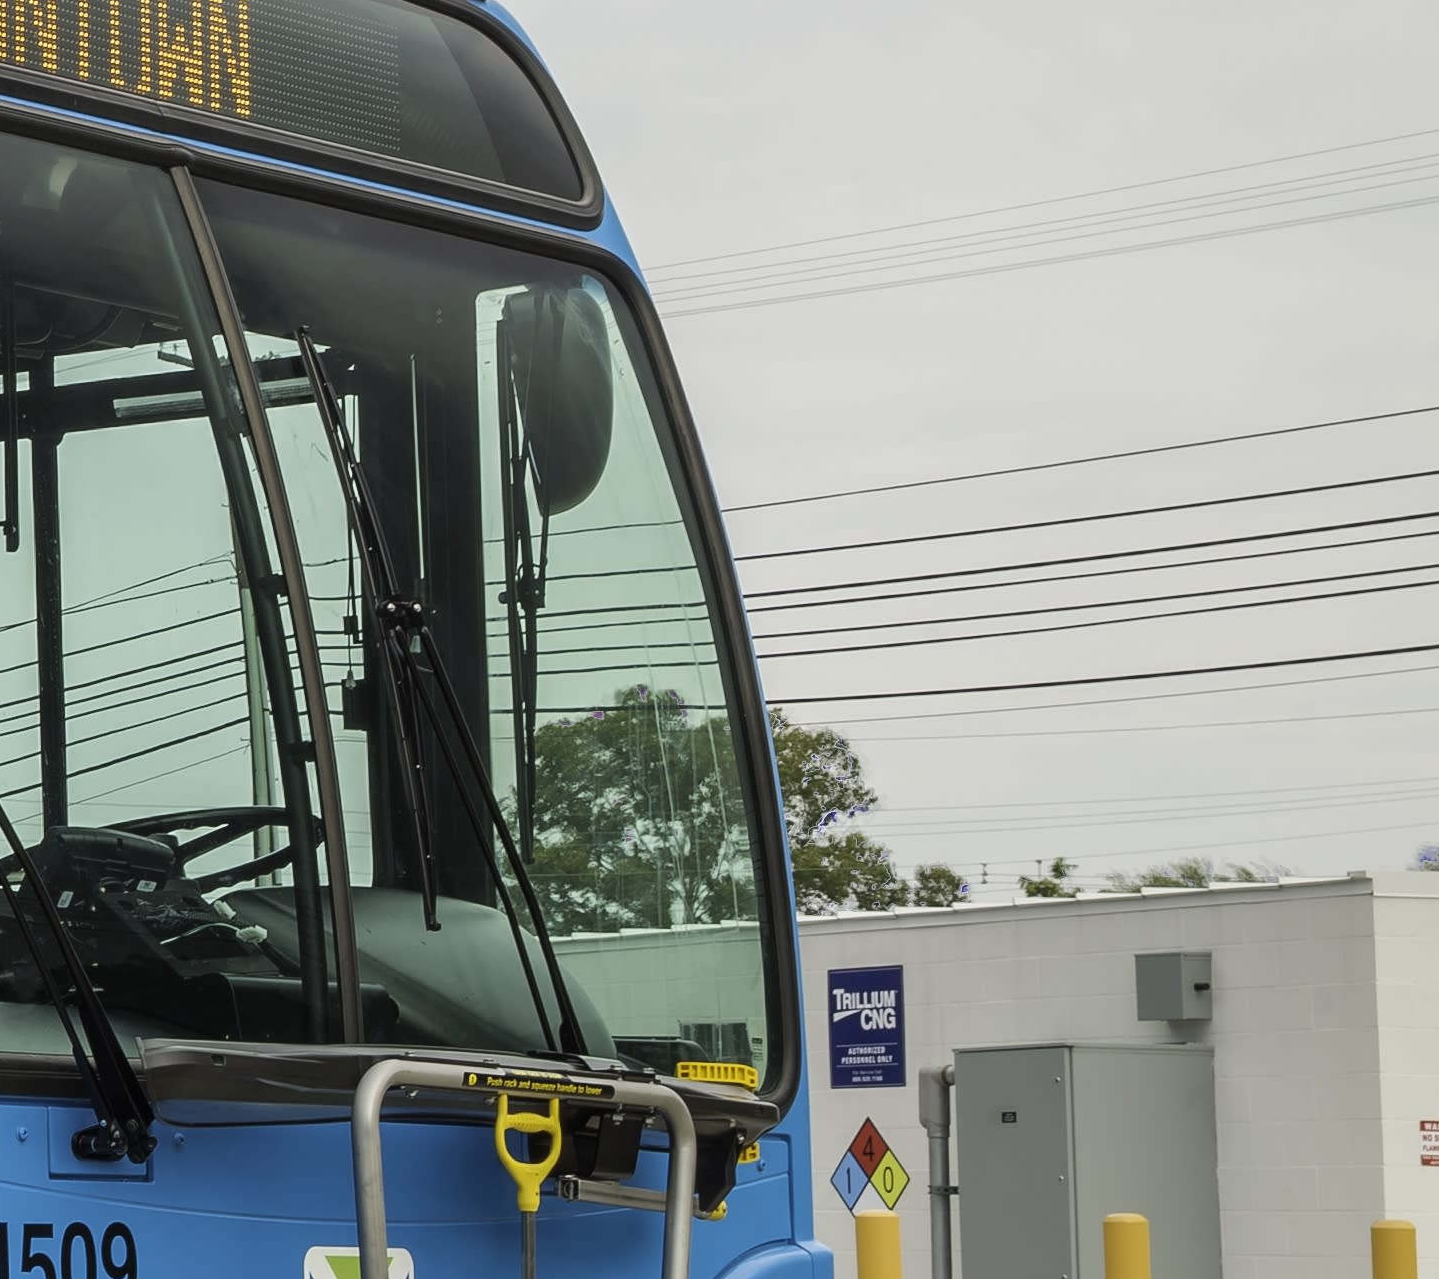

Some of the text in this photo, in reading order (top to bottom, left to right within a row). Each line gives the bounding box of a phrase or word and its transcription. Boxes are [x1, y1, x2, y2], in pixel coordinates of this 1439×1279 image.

[832, 988, 896, 1010] TRILLIUM
[860, 1007, 897, 1031] CNG
[840, 1055, 893, 1065] PERSONNEL ONLY
[847, 1046, 886, 1056] AUTHORIZED
[863, 1135, 876, 1161] 4
[846, 1166, 894, 1194] 1 0
